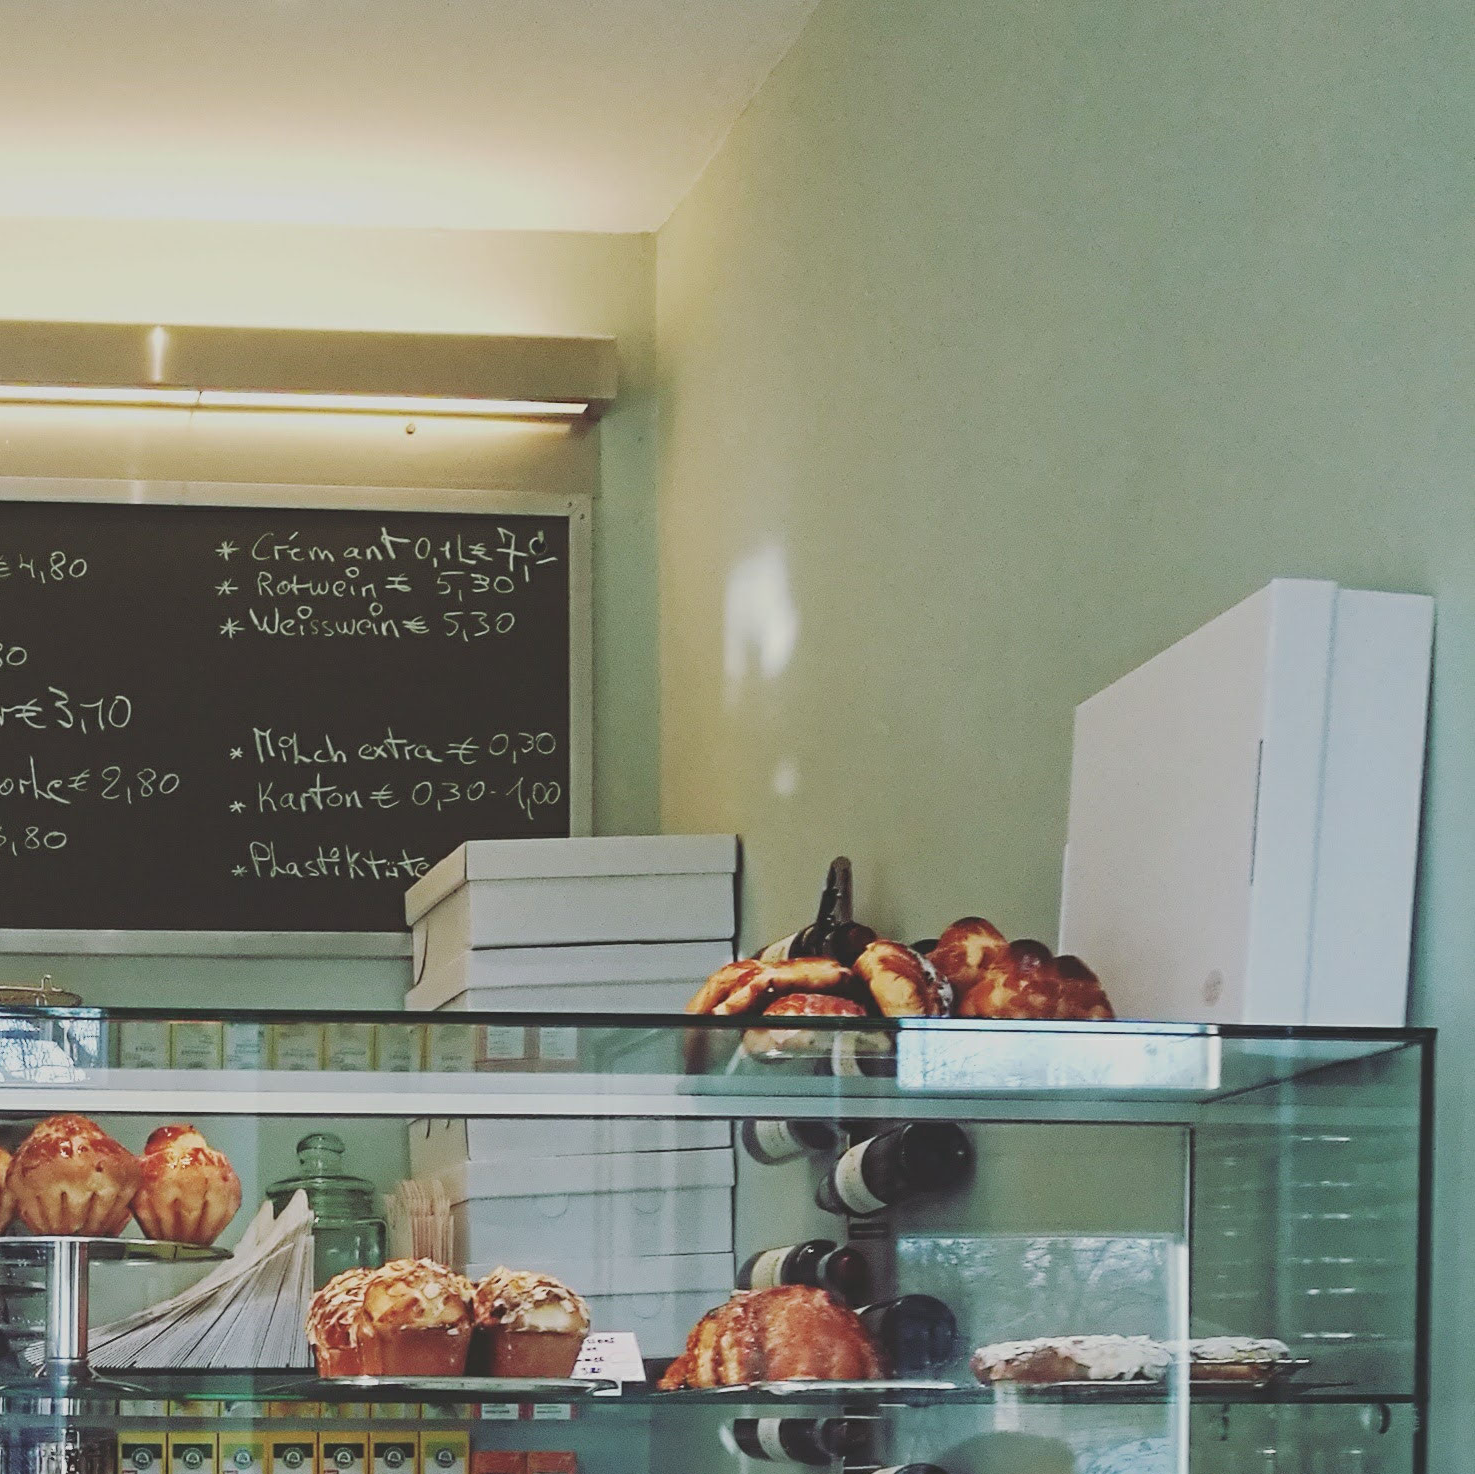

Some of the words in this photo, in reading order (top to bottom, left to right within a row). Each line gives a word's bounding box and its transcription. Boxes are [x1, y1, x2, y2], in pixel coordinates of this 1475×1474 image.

[252, 527, 411, 562] Crémant
[19, 551, 87, 583] 4,80
[257, 567, 376, 598] Rotwein
[437, 571, 514, 601] 5,30
[249, 602, 399, 638] Weisswein
[444, 612, 515, 642] 5,30
[253, 728, 347, 764] Milch
[358, 727, 443, 762] extra
[446, 737, 479, 764] €
[489, 732, 555, 764] 0,30
[101, 766, 179, 804] 2,80
[259, 773, 363, 812] Karton
[369, 784, 399, 808] €
